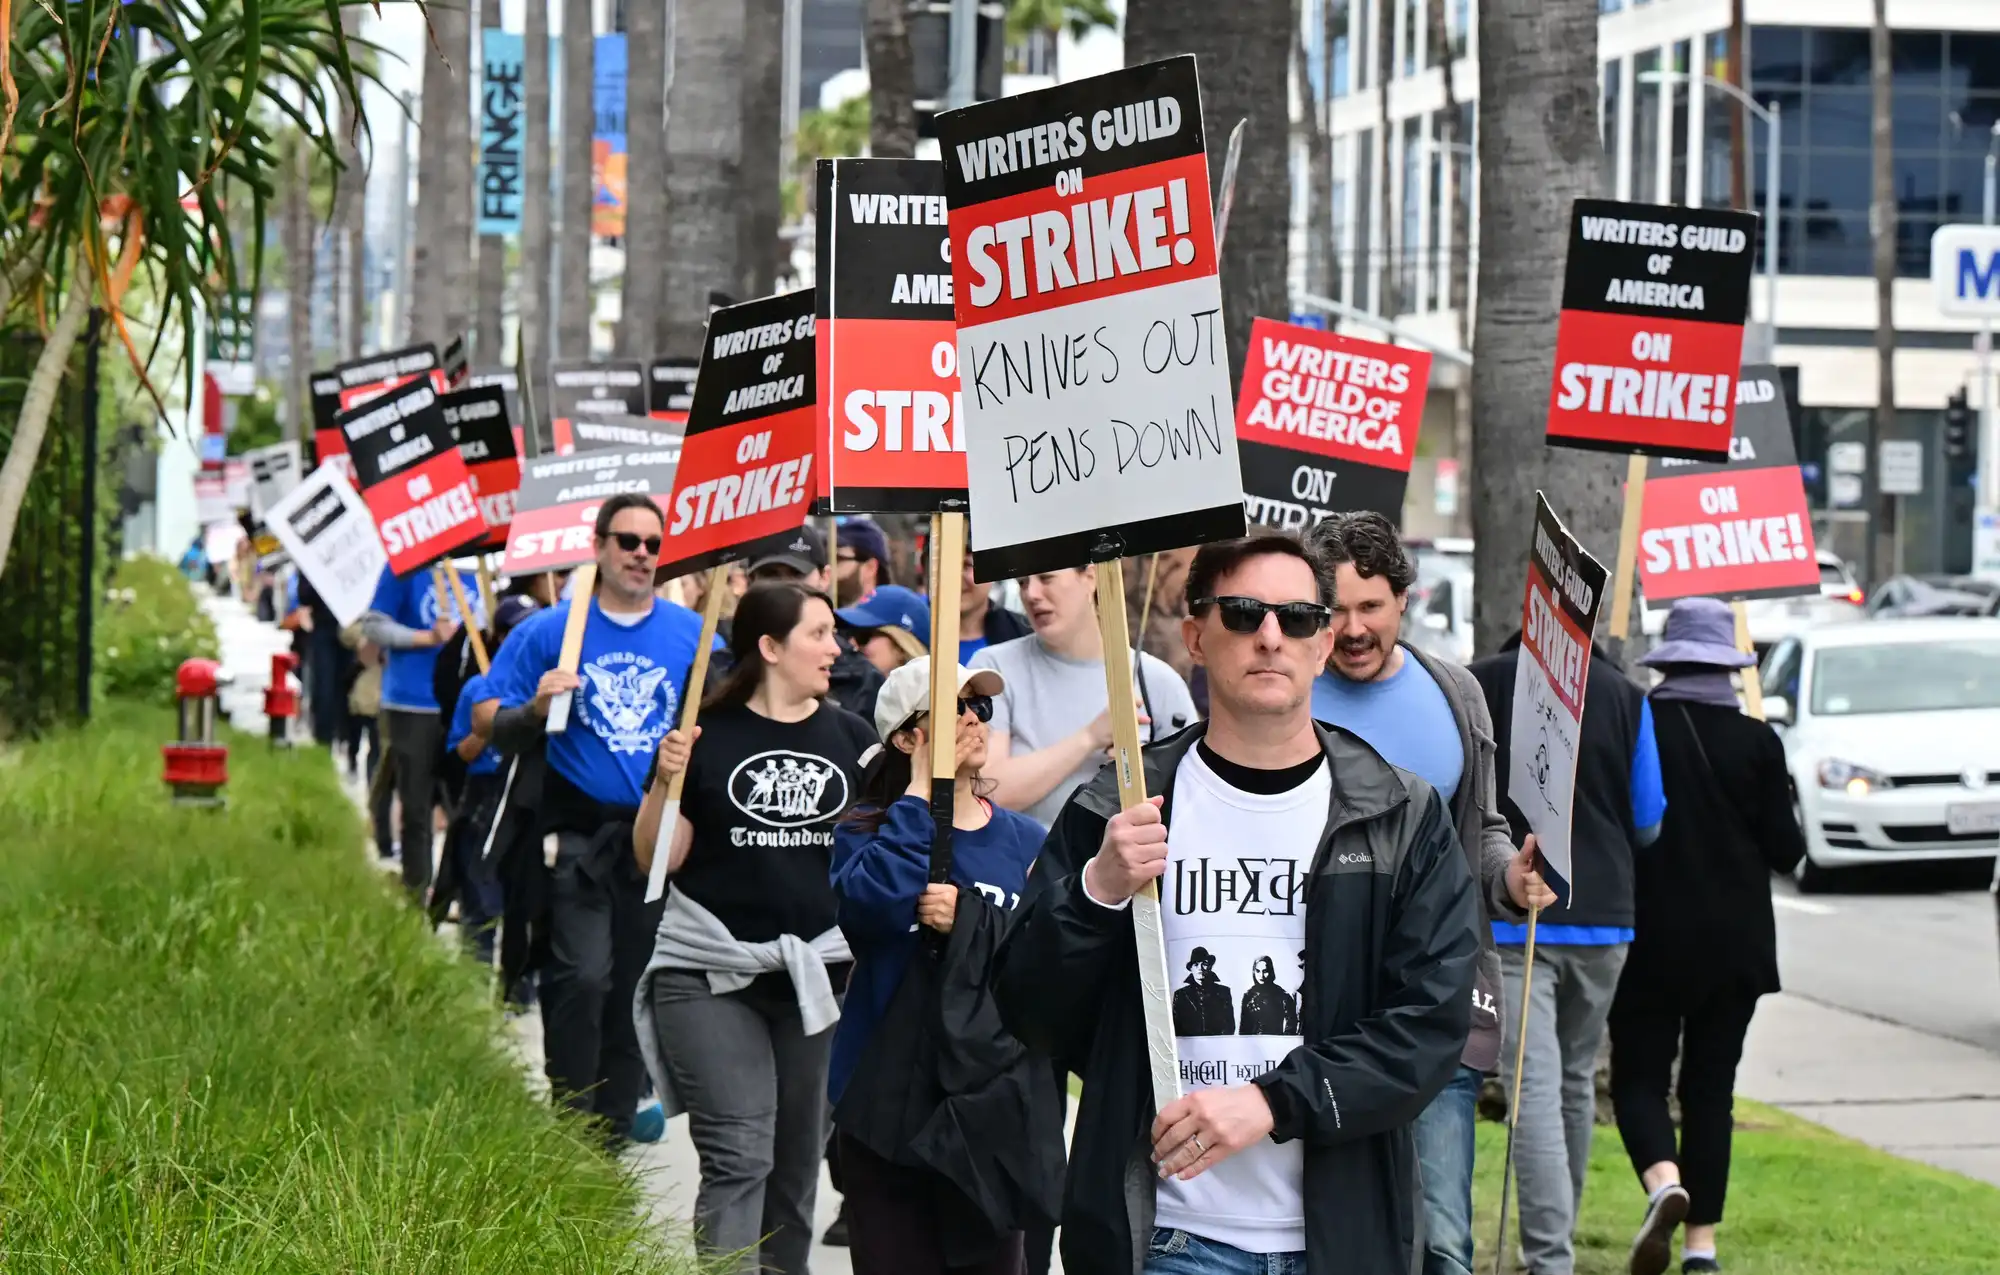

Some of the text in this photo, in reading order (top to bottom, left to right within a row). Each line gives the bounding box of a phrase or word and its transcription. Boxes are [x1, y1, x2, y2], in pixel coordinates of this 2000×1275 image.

[483, 63, 522, 220] FRINGE
[956, 96, 1182, 183] WRITERS GUILD
[1055, 167, 1083, 197] ON
[966, 177, 1195, 307] STRIKE!
[1581, 216, 1747, 254] WRITERS GUILD
[1647, 253, 1673, 275] OF
[1605, 278, 1705, 310] AMERICA
[713, 319, 793, 360] WRITERS
[931, 341, 960, 379] O
[971, 308, 1220, 410] KNIVES OUT
[1631, 331, 1672, 363] ON
[762, 352, 784, 375] OF
[1262, 337, 1410, 394] WRITERS
[722, 374, 805, 415] AMERICA
[1261, 370, 1402, 422] GUILD OF
[1557, 362, 1730, 425] STRIKE!
[736, 430, 772, 464] ON
[1003, 395, 1221, 503] PENS DOWN
[1246, 398, 1404, 455] AMERICA
[532, 454, 622, 479] WRITERS
[1291, 465, 1337, 504] ON
[556, 479, 650, 502] AMERICA
[669, 453, 813, 536] STRIKE!
[1700, 486, 1739, 515] ON
[380, 482, 477, 555] STRIKE!
[1641, 513, 1808, 574] STRIKE!
[1535, 520, 1593, 616] WRITERS GUILD
[1527, 583, 1584, 707] STRIKE!
